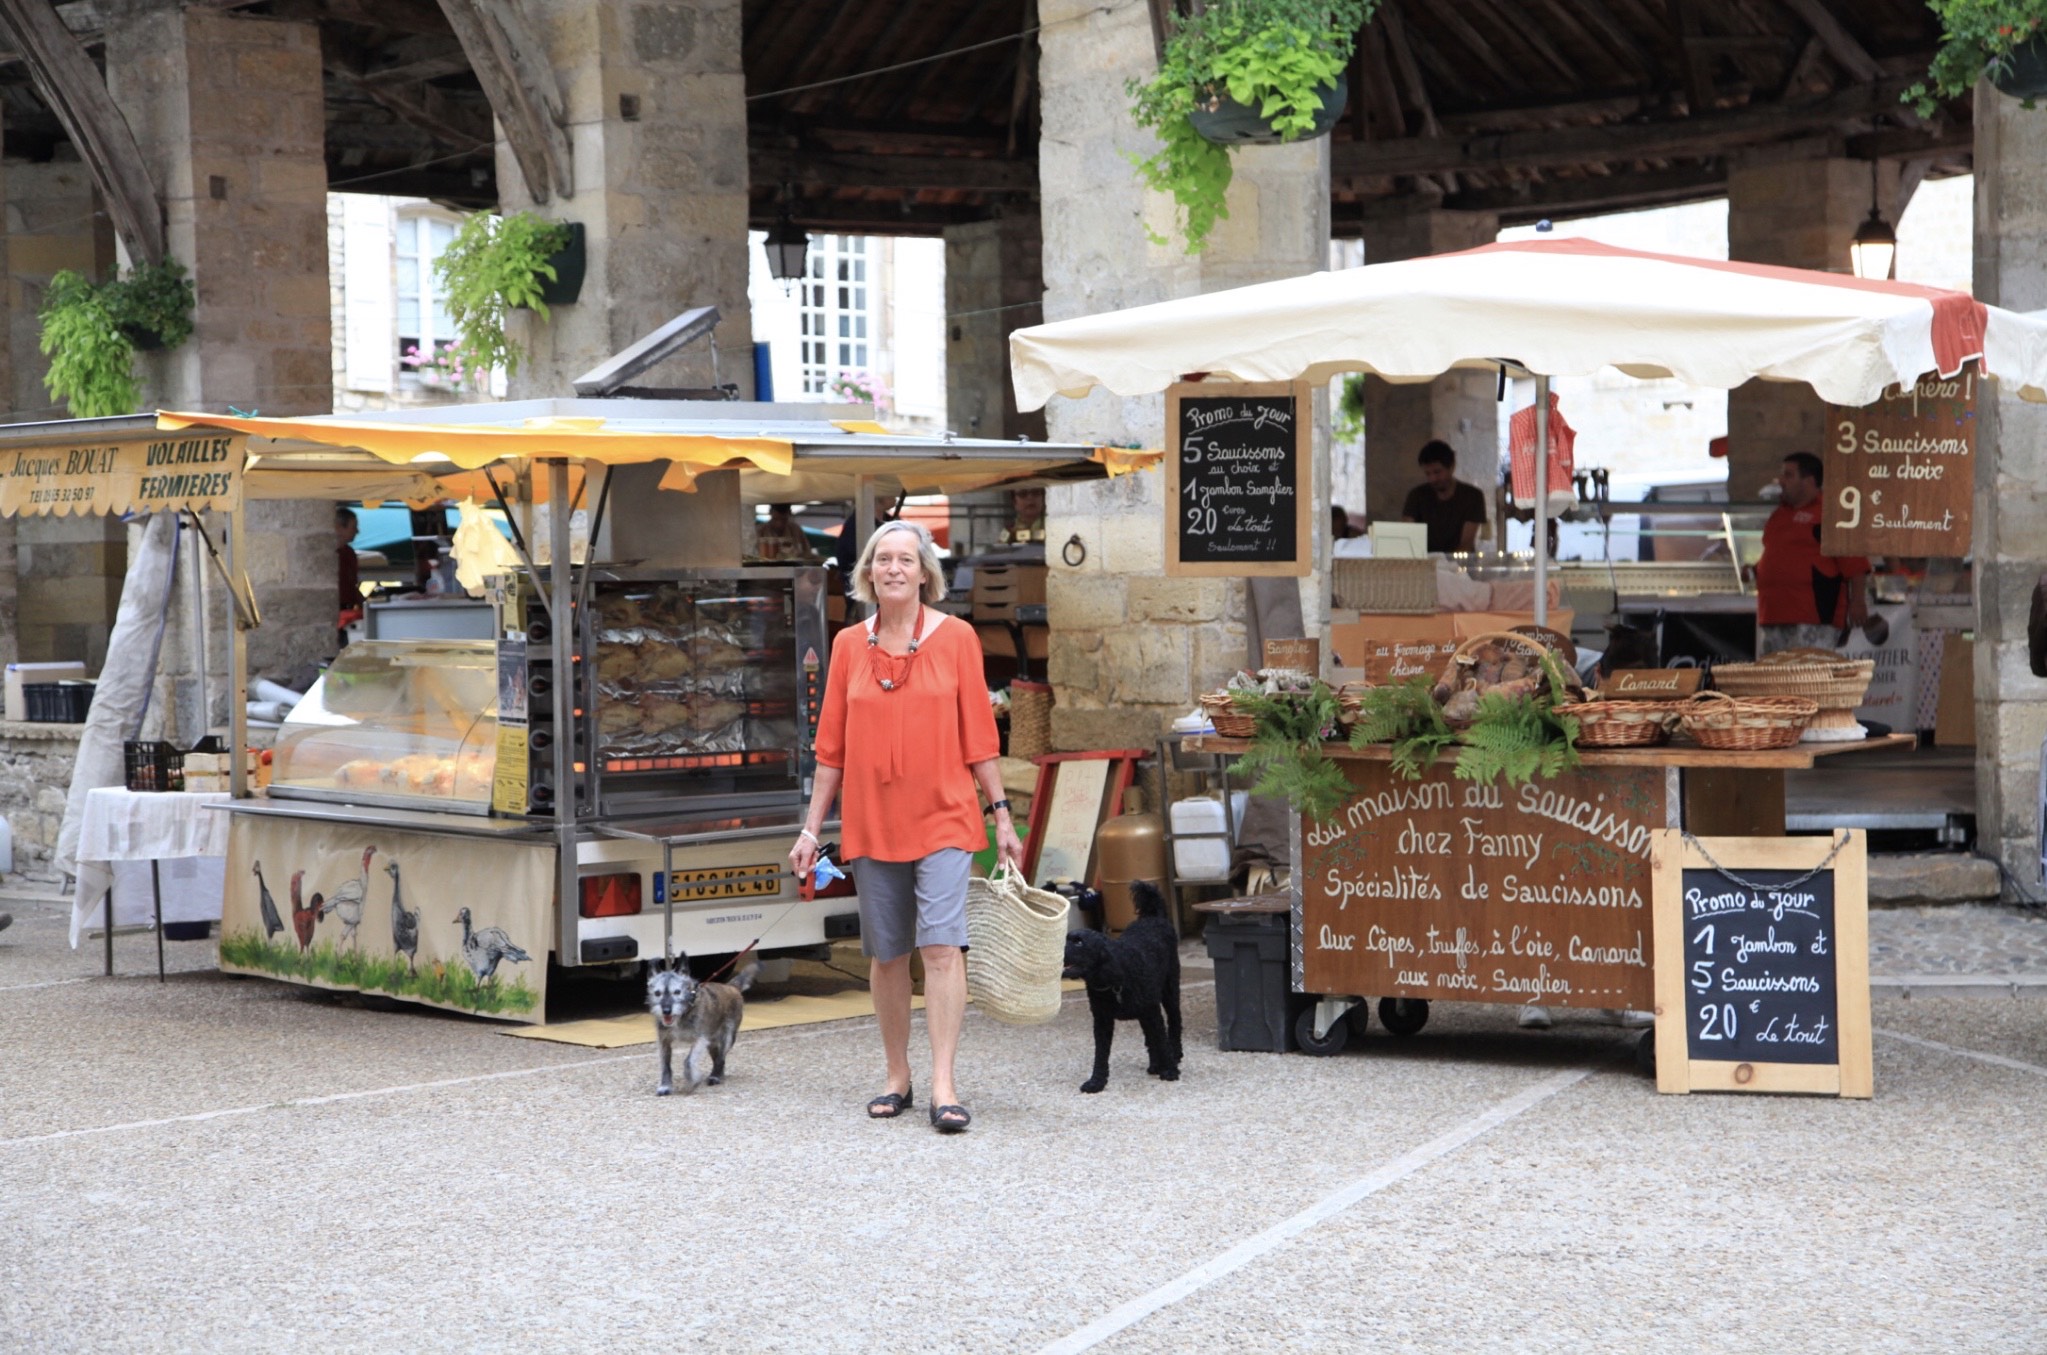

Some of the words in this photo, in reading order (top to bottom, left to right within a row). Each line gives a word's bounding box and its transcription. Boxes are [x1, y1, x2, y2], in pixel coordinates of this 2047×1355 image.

[1186, 407, 1233, 428] Promo
[1240, 403, 1253, 417] du
[1254, 405, 1291, 430] Jour
[147, 437, 232, 466] VOLAILLES
[1183, 436, 1204, 463] 5
[1207, 441, 1285, 461] Saucissons
[1836, 421, 1857, 454] 3
[1862, 429, 1968, 455] Saucissons
[11, 452, 61, 483] Jacques
[65, 447, 118, 475] BOUAT
[1208, 465, 1225, 475] au
[1231, 460, 1260, 474] choix
[1268, 461, 1280, 472] et
[1868, 465, 1890, 478] au
[1896, 454, 1944, 480] choix
[139, 472, 232, 499] FERMIERES
[1183, 477, 1197, 500] 1
[1200, 476, 1244, 509] Jambon
[1246, 475, 1294, 505] Sanglier
[1186, 507, 1217, 534] 20
[1227, 515, 1244, 532] Le
[1244, 514, 1273, 532] tout
[1835, 486, 1861, 528] 9
[1871, 504, 1954, 531] Seulement
[1376, 646, 1389, 657] au
[1442, 639, 1456, 653] de
[1615, 671, 1680, 691] Canard
[1347, 778, 1454, 829] maison
[1462, 781, 1503, 808] du
[1395, 818, 1452, 854] chez
[1460, 817, 1543, 870] Fanny
[1324, 865, 1442, 910] Spécialités
[1461, 864, 1489, 900] de
[1501, 874, 1643, 909] Saucissons
[1685, 888, 1746, 914] Promo
[1750, 892, 1765, 909] du
[1768, 891, 1815, 921] Jour
[1316, 924, 1356, 951] Aux
[1489, 929, 1505, 956] à
[1568, 930, 1647, 967] Canard
[1692, 924, 1715, 955] 1
[1730, 925, 1797, 964] Jambon
[1811, 929, 1828, 955] et
[1394, 970, 1429, 986] aux
[1691, 961, 1715, 988] 5
[1721, 967, 1821, 993] Saucissons
[1699, 1003, 1737, 1040] 20
[1749, 999, 1761, 1014] €
[1756, 1017, 1779, 1043] Le
[1783, 1013, 1829, 1045] tout
